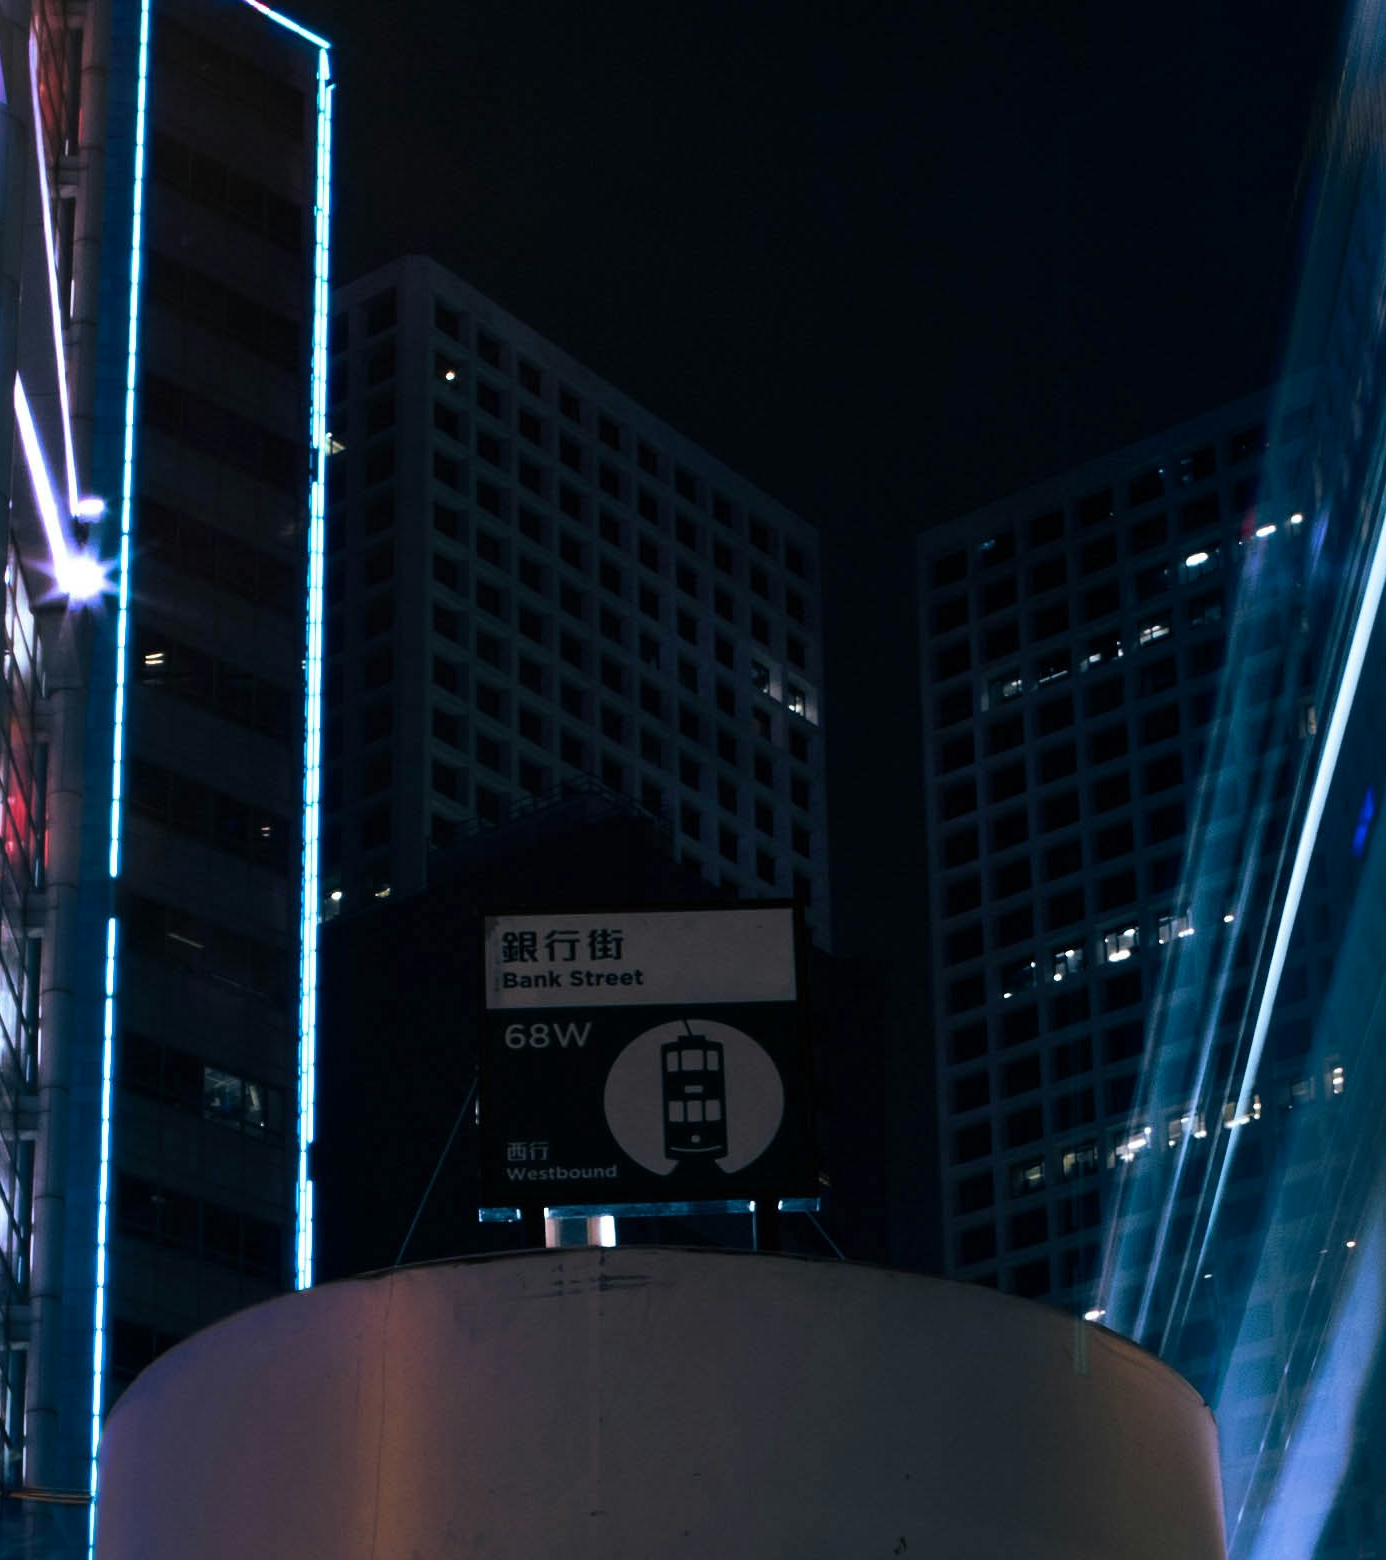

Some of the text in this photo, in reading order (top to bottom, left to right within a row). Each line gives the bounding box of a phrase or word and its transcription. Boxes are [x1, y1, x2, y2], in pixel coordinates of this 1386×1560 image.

[502, 928, 624, 963] 銀行街
[503, 969, 644, 989] Bank Street
[504, 1020, 593, 1049] 68W
[506, 1140, 550, 1162] 西行
[506, 1164, 618, 1182] Westbound
